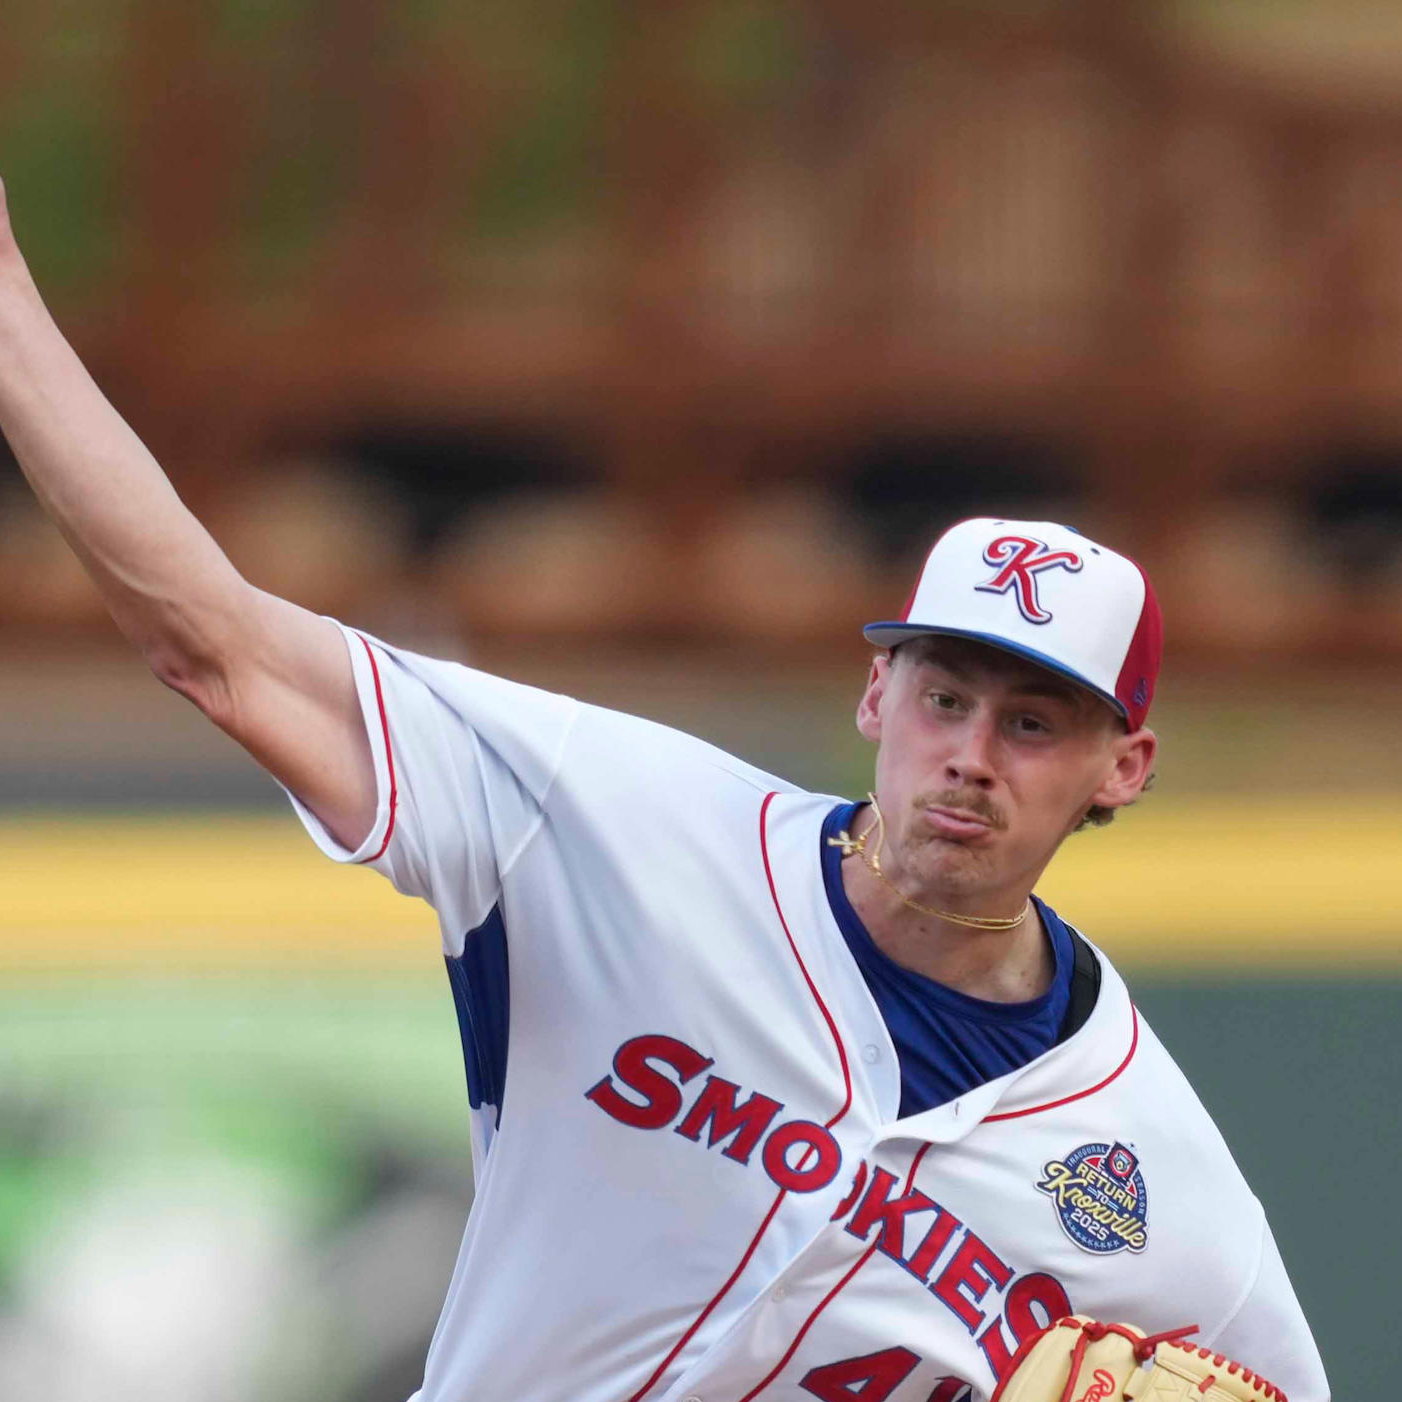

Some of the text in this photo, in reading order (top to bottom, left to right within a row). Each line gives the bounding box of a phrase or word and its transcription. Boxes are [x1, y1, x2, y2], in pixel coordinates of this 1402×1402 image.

[974, 535, 1083, 625] K
[1066, 1144, 1107, 1167] INAUGURAL
[584, 1034, 1073, 1383] SMOKIES
[1043, 1162, 1146, 1248] Knoxville
[1075, 1161, 1138, 1212] RETURN
[1096, 1190, 1109, 1205] TO
[1070, 1207, 1110, 1242] 2025
